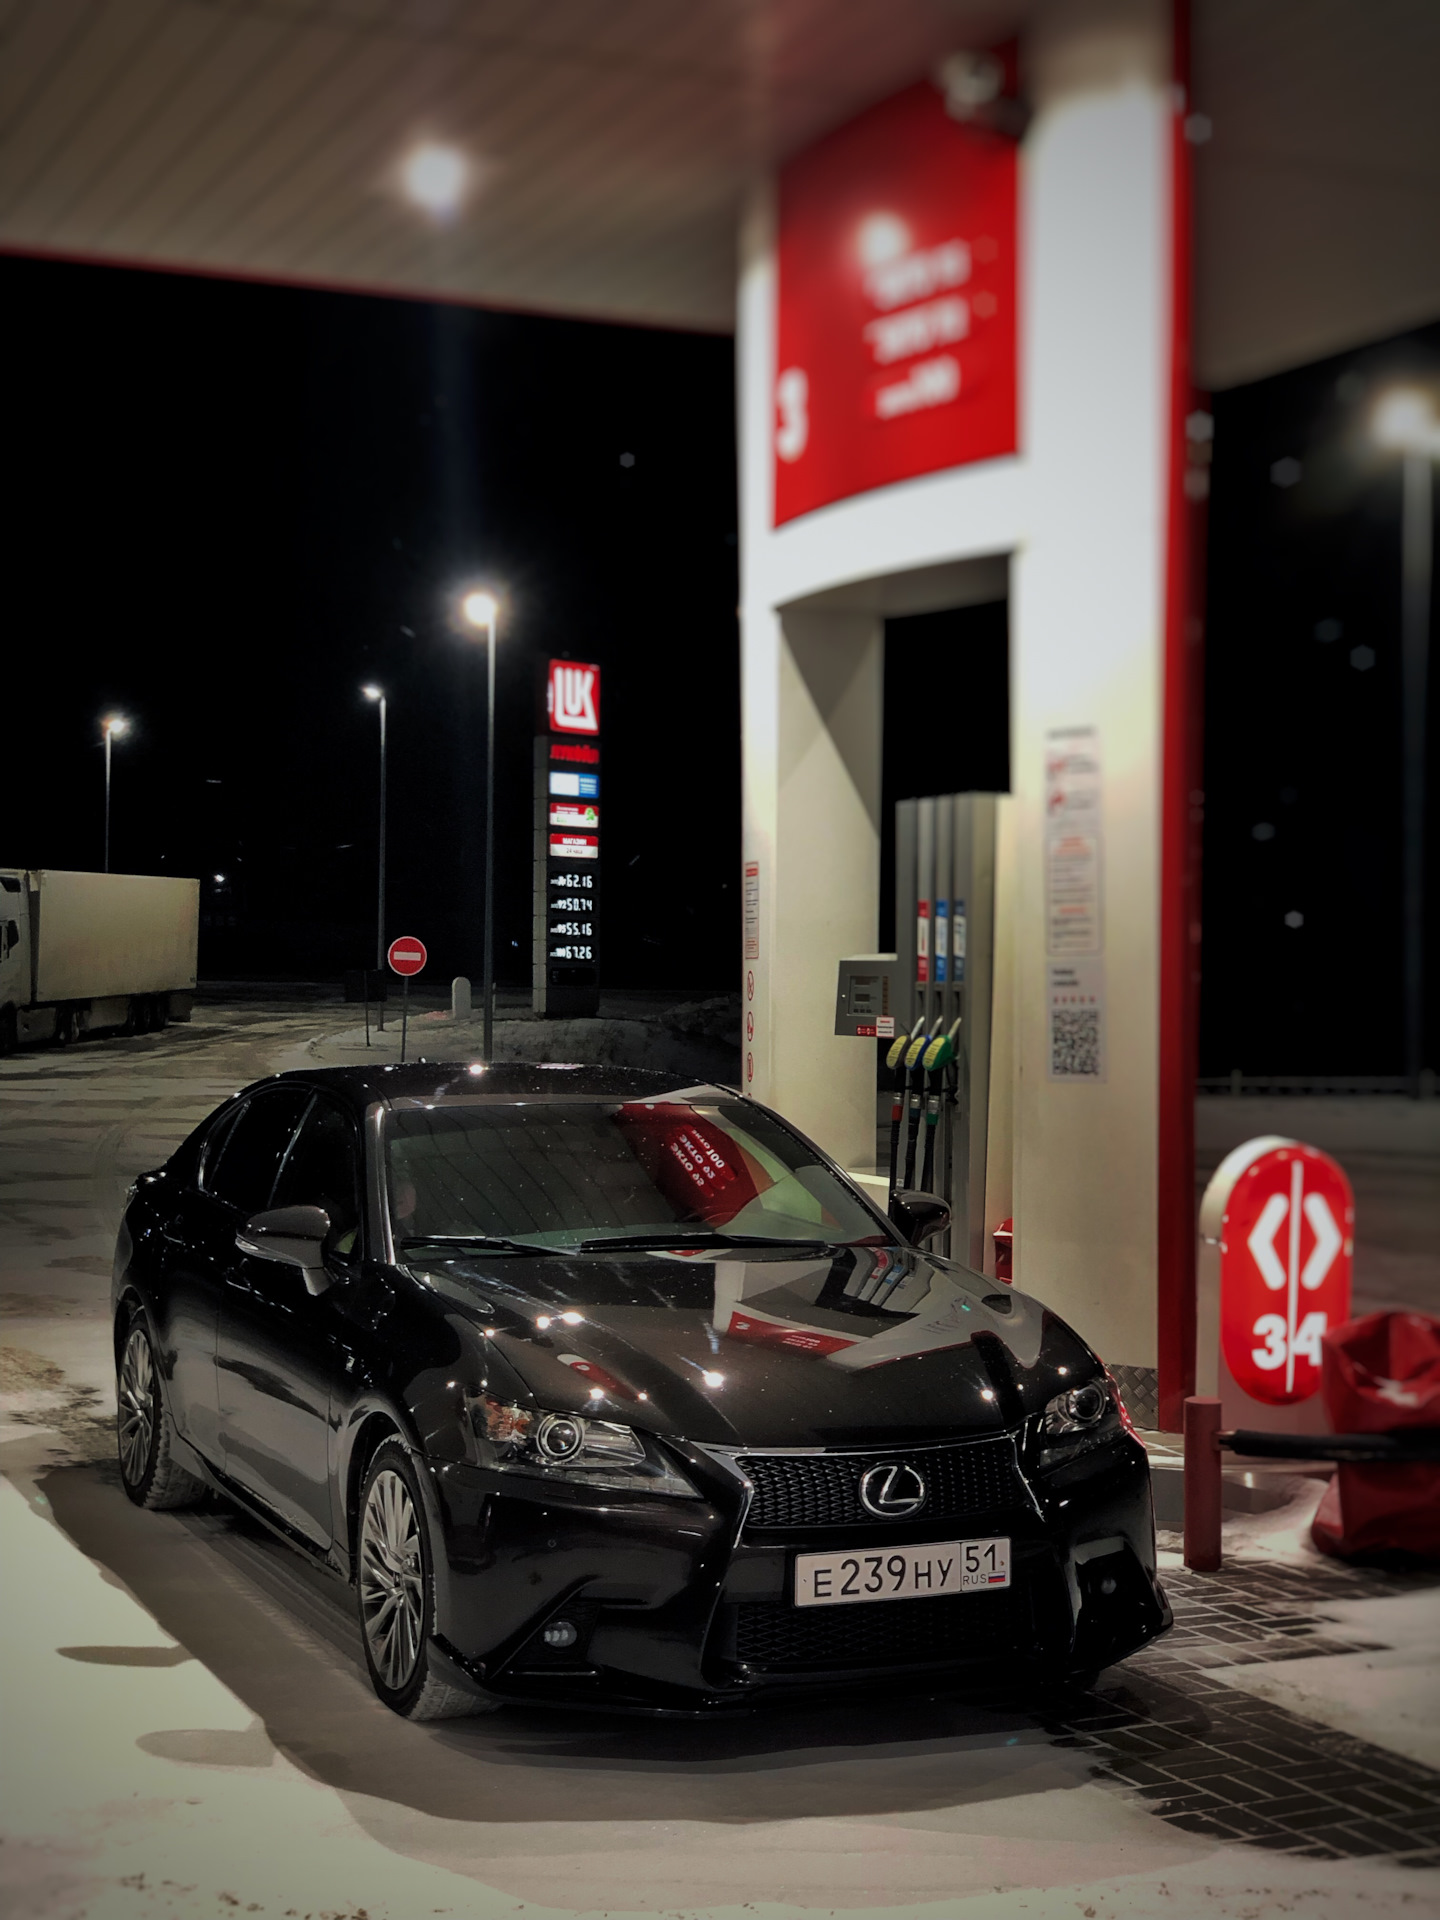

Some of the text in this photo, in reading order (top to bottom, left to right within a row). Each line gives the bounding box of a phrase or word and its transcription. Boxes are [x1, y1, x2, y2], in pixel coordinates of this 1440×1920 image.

[566, 873, 593, 888] 62.16
[566, 922, 592, 936] 55.16
[565, 946, 592, 959] 67.26
[965, 1544, 997, 1573] 51
[963, 1572, 987, 1586] RUS
